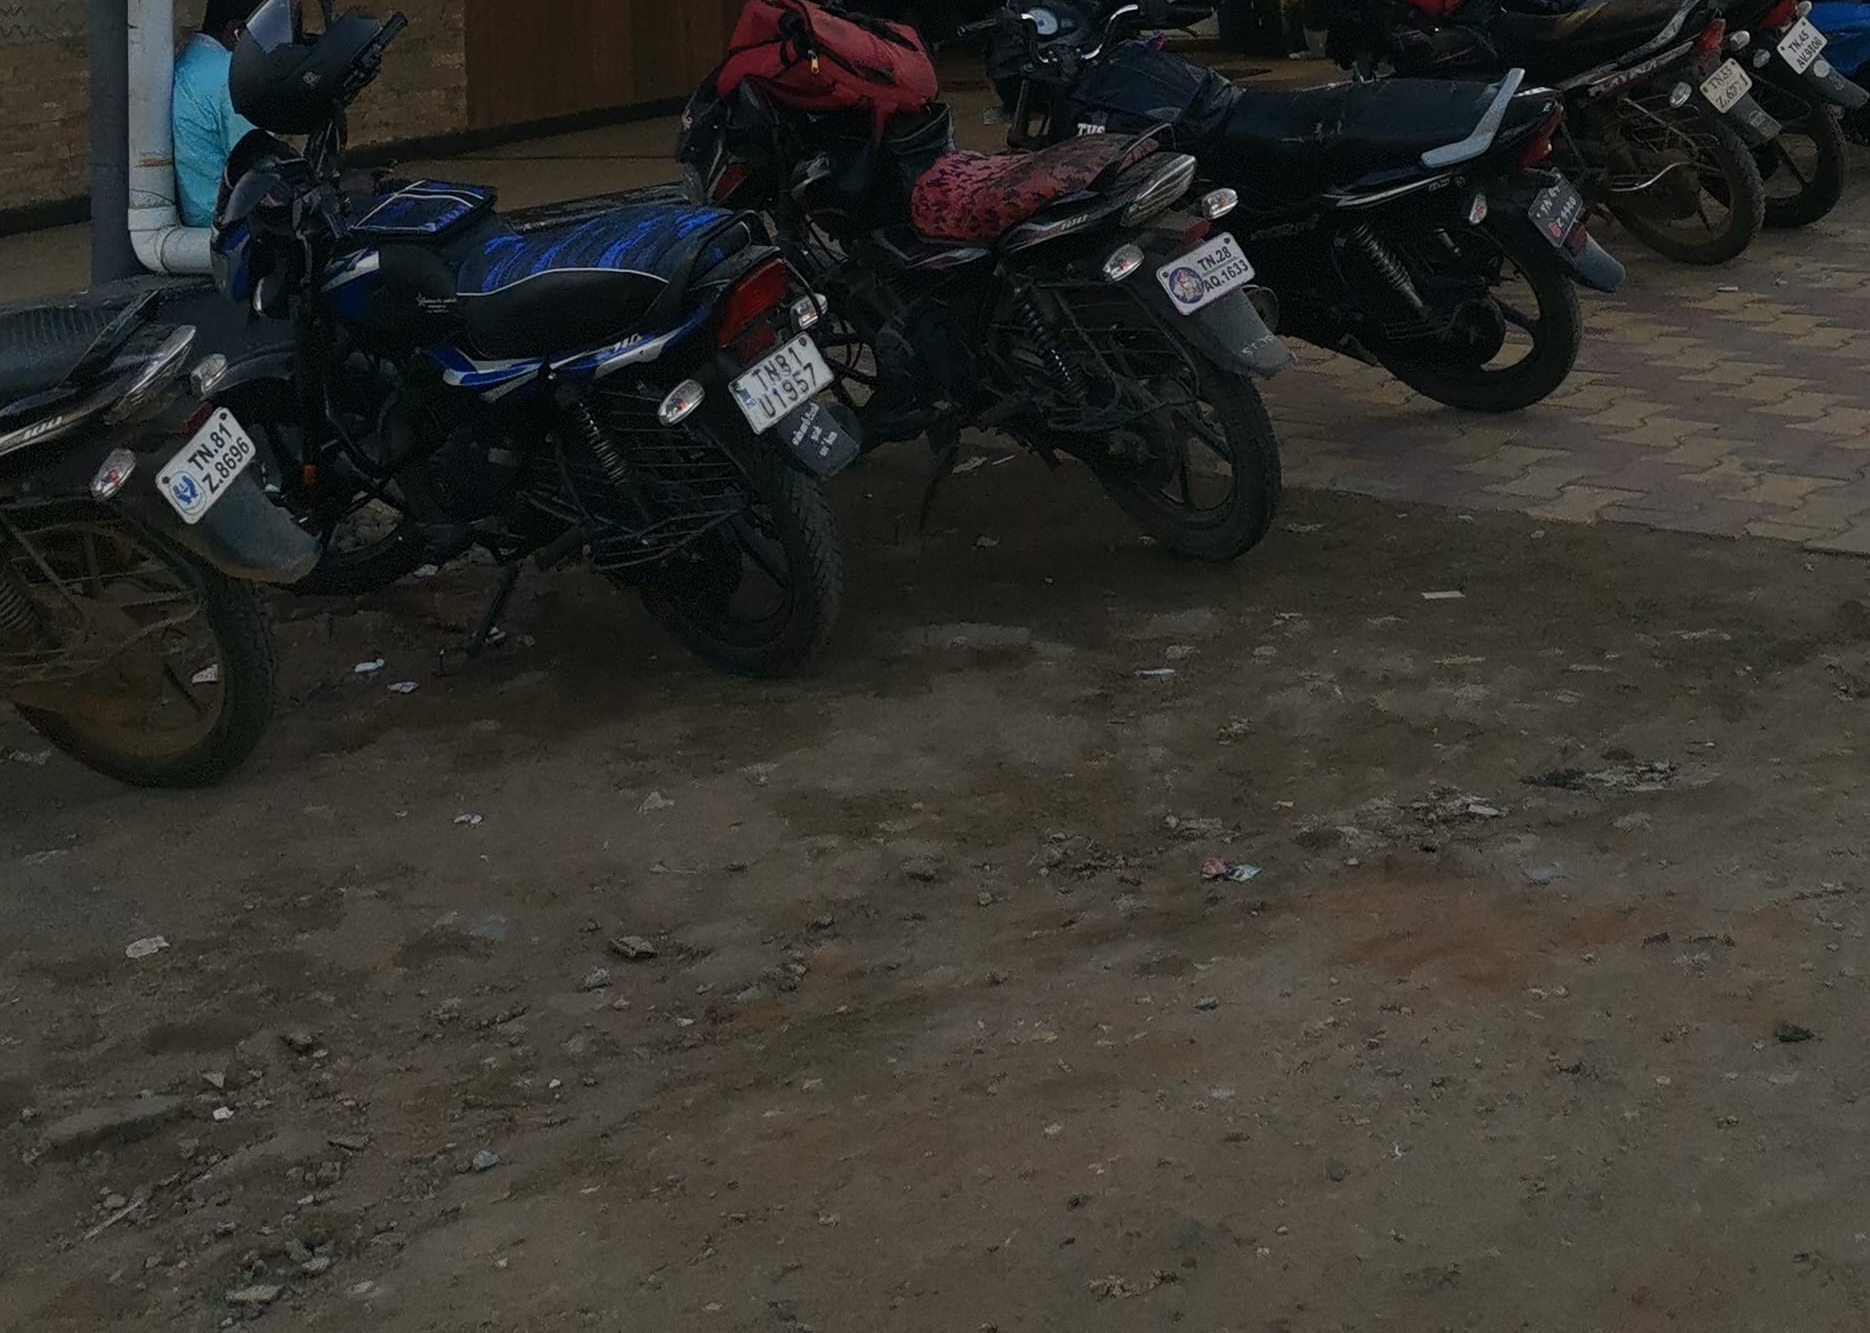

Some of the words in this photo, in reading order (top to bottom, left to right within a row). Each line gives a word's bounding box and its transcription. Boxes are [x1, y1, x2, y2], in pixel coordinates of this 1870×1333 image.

[1197, 246, 1233, 271] TN.28
[188, 422, 232, 471] TN.81
[202, 437, 250, 494] Z.8696
